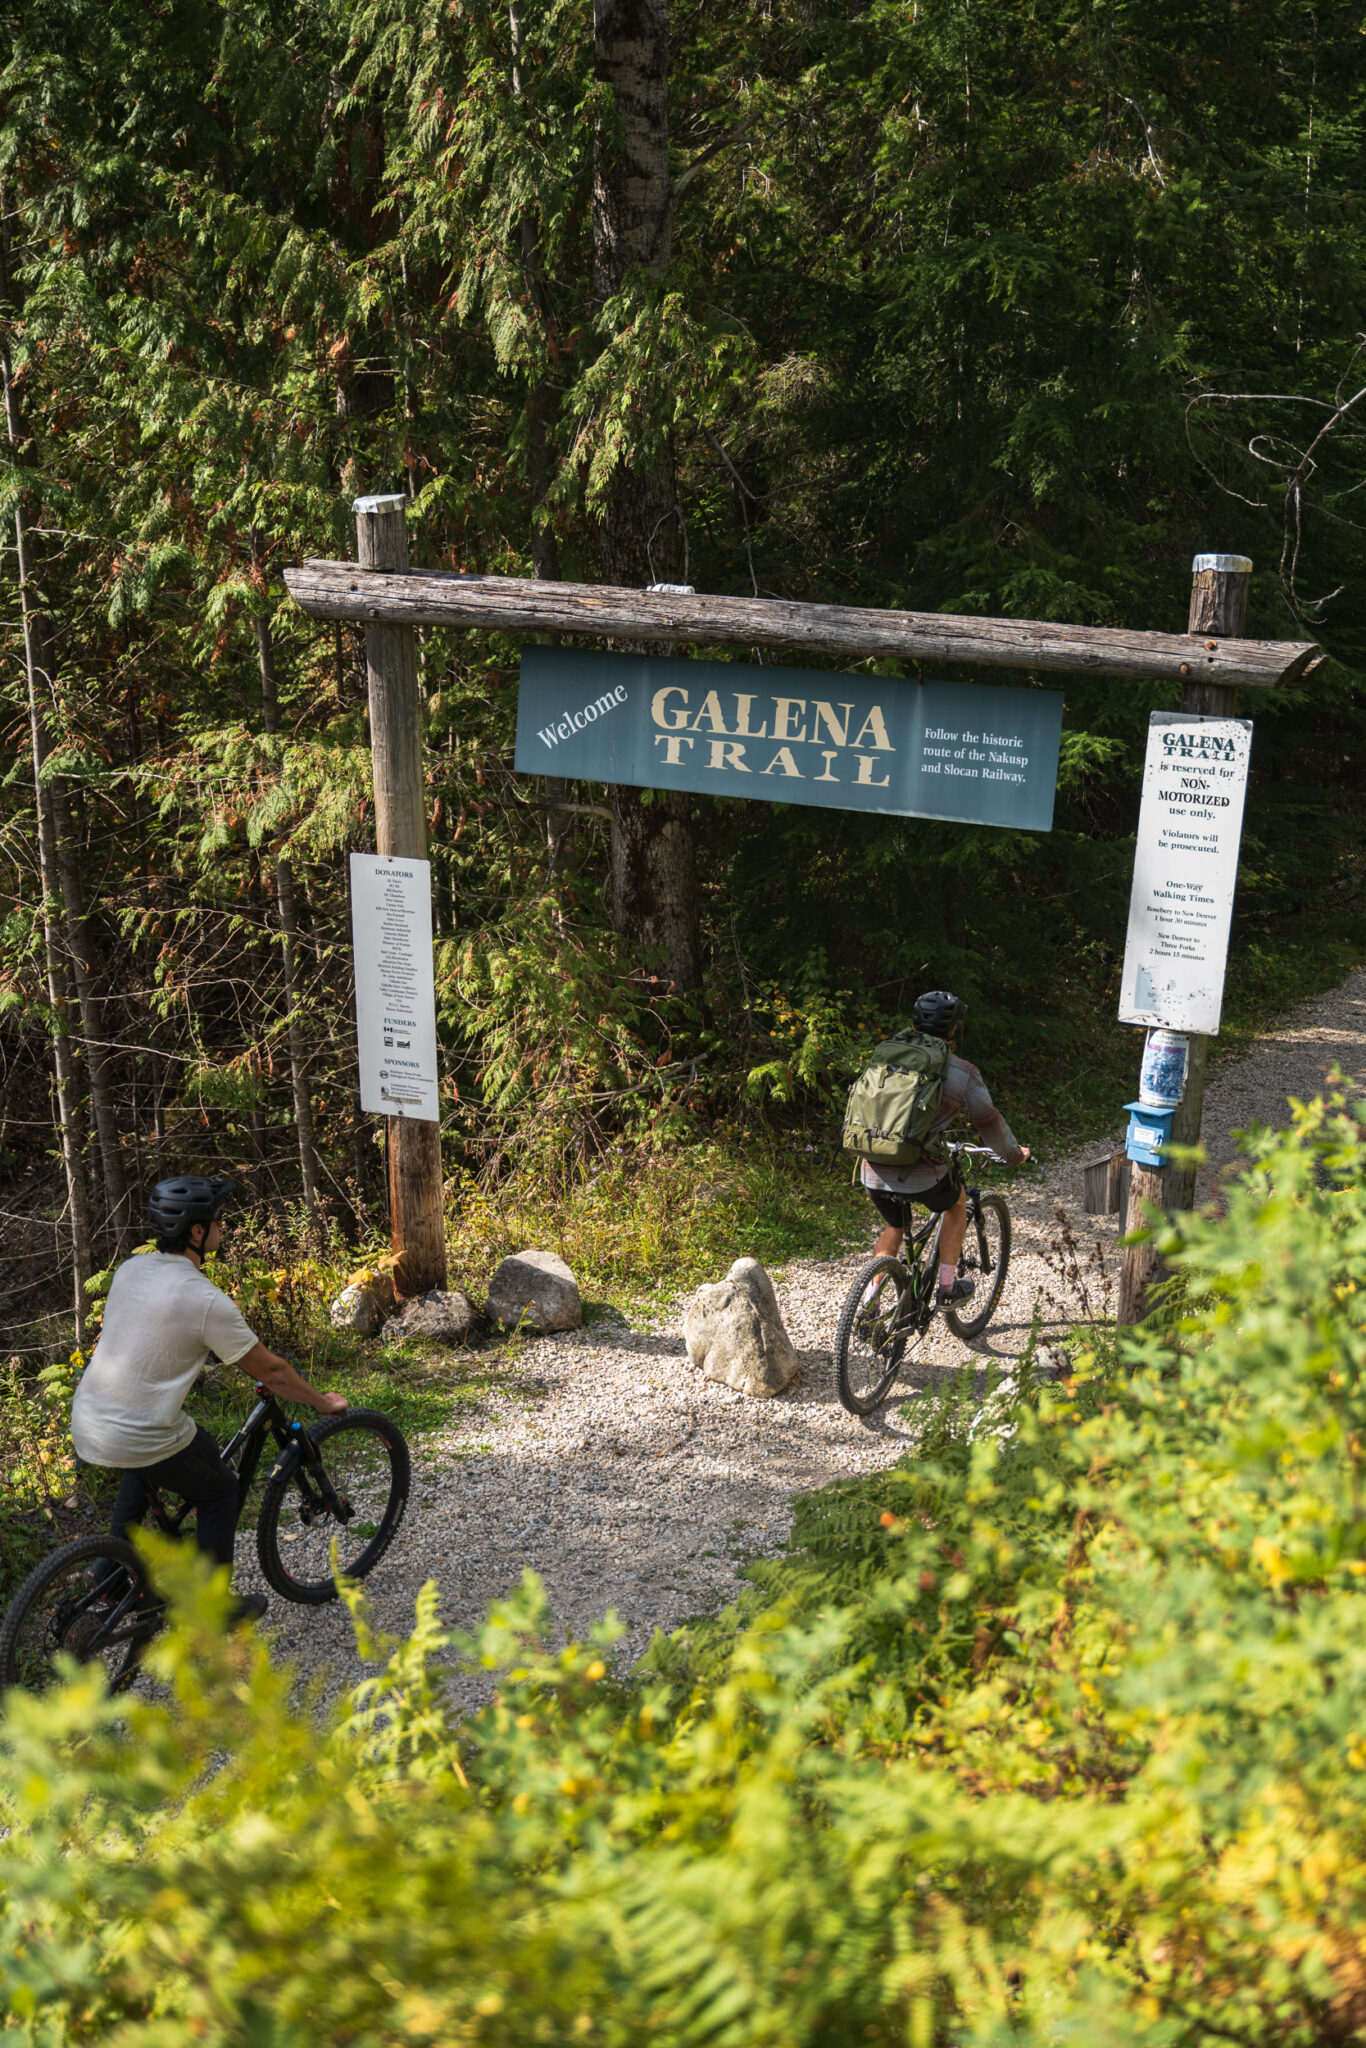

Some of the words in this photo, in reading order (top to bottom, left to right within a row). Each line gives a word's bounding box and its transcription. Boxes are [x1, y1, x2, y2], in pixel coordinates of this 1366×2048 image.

[536, 684, 628, 750] Welcome
[651, 686, 896, 751] GALENA
[924, 728, 958, 741] Follow
[962, 731, 979, 744] the
[982, 733, 1024, 748] historic
[1162, 732, 1236, 752] GALENA
[923, 747, 951, 758] route
[954, 748, 966, 759] of
[969, 750, 986, 761] the
[988, 752, 1029, 768] Nakusp
[1163, 746, 1235, 762] TRAIL
[654, 735, 890, 788] TRAIL
[921, 762, 941, 774] and
[944, 764, 978, 777] Slocan
[982, 768, 1026, 784] Railway.
[1160, 762, 1168, 770] is
[1172, 764, 1216, 776] reserved
[1219, 768, 1235, 777] for
[1180, 778, 1210, 790] NON-
[1158, 791, 1230, 807] MOTORIZED
[1169, 808, 1186, 816] use
[1190, 809, 1216, 820] only.
[1162, 829, 1200, 840] Violators
[1202, 834, 1218, 842] will
[1171, 842, 1220, 854] prosecuted.
[375, 868, 414, 879] DONATORS
[1166, 880, 1203, 893] One-Way
[1153, 890, 1186, 902] Walking
[1189, 894, 1214, 904] Times
[1172, 934, 1192, 942] Denver
[1160, 941, 1177, 950] Three
[1155, 949, 1171, 957] hours
[1182, 953, 1205, 961] minutes
[384, 1018, 416, 1027] FUNDERS
[384, 1058, 420, 1068] SPONSORS
